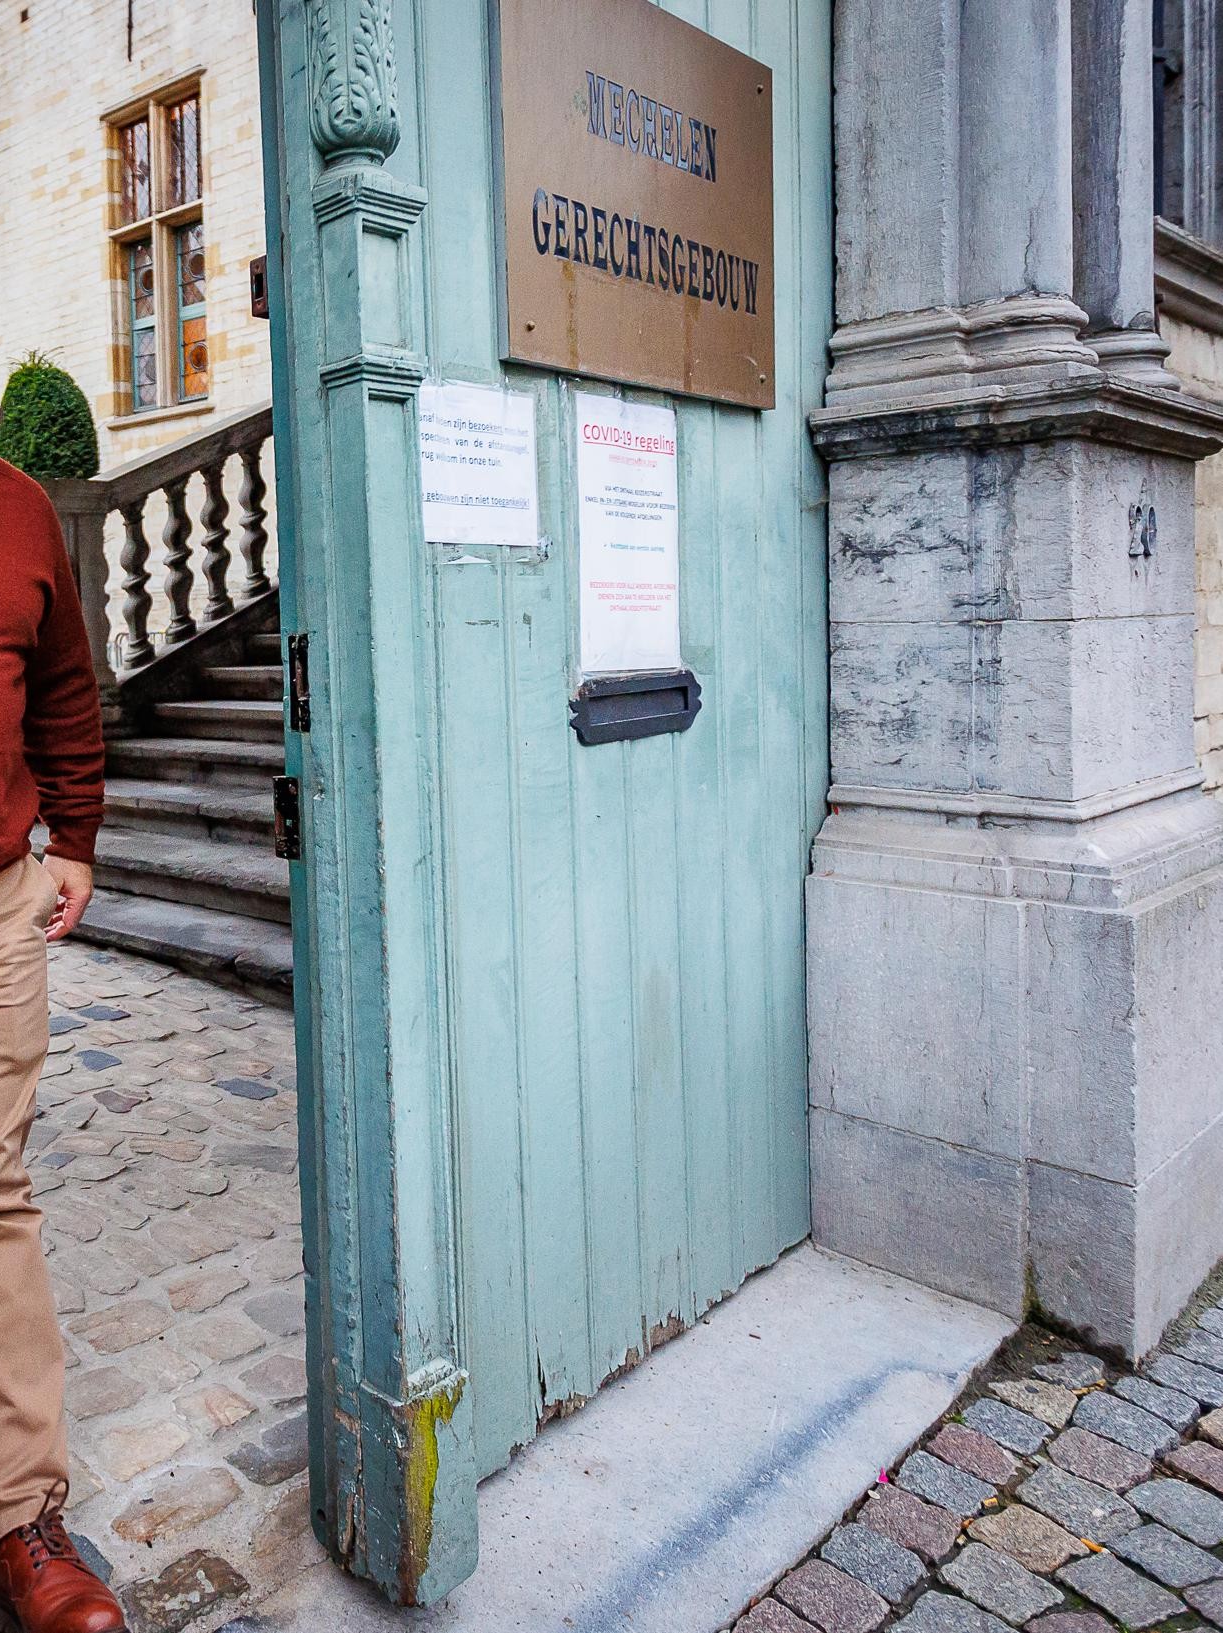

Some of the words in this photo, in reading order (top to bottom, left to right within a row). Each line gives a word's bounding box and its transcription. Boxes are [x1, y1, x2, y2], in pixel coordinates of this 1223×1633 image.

[585, 70, 717, 182] MECHELEN
[531, 187, 759, 315] GERECHTSGEBOUW
[455, 438, 469, 447] van
[473, 437, 484, 449] de
[583, 424, 632, 446] COVID-19
[635, 434, 675, 455] regeling
[469, 457, 486, 466] onze
